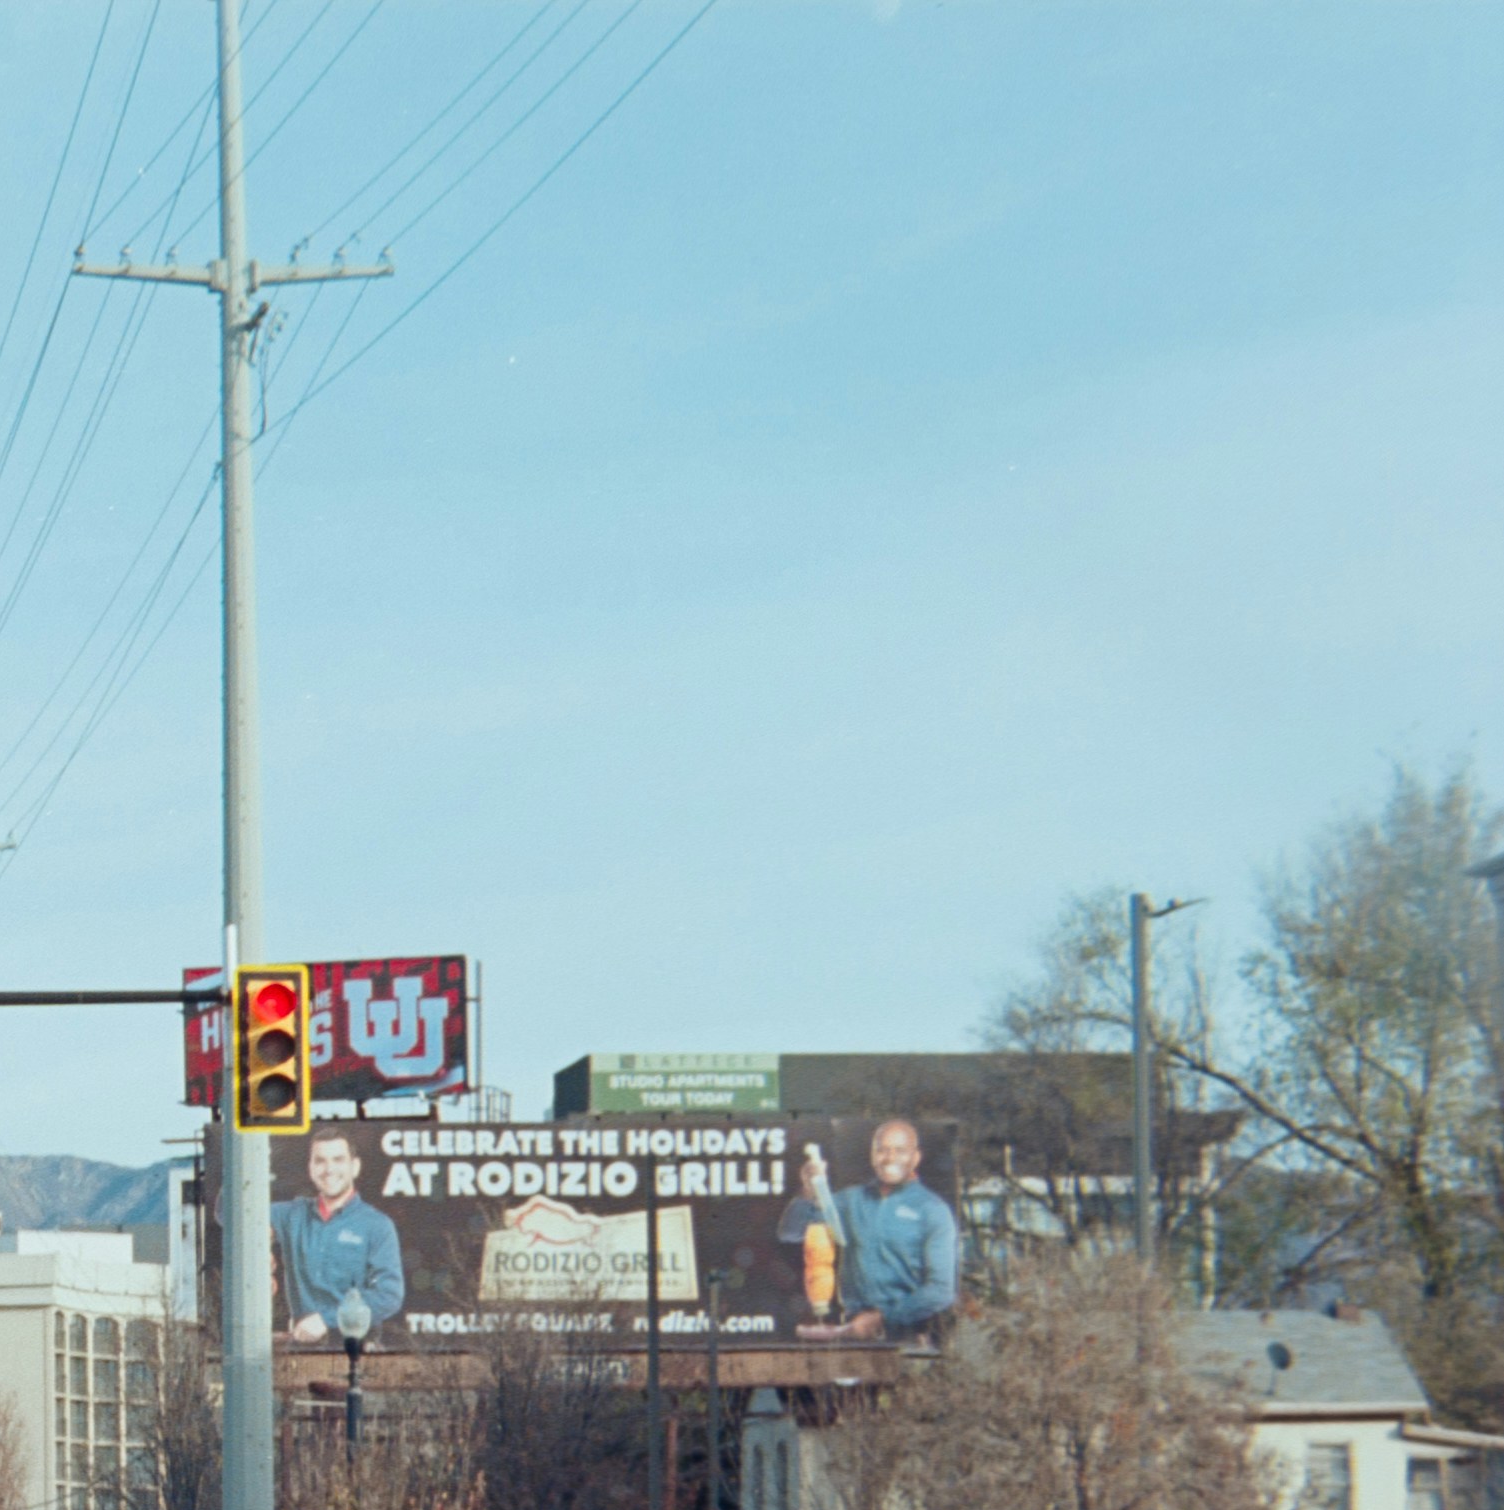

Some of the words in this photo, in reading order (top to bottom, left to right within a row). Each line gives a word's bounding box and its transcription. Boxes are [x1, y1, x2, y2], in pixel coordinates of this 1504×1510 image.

[609, 1073, 665, 1089] STUDIO
[667, 1072, 767, 1088] APARTMENTS
[641, 1090, 683, 1107] TOUR
[685, 1090, 735, 1107] TODAY
[381, 1129, 554, 1157] CELEBRATE
[558, 1129, 620, 1156] THE
[625, 1128, 787, 1156] HOLIDAYS
[381, 1161, 440, 1197] AT
[447, 1161, 639, 1197] RODIZIO
[653, 1160, 786, 1196] GRILL!
[493, 1251, 603, 1274] RODIZIO
[610, 1251, 684, 1273] GRLL
[633, 1309, 775, 1333] rdizi.com
